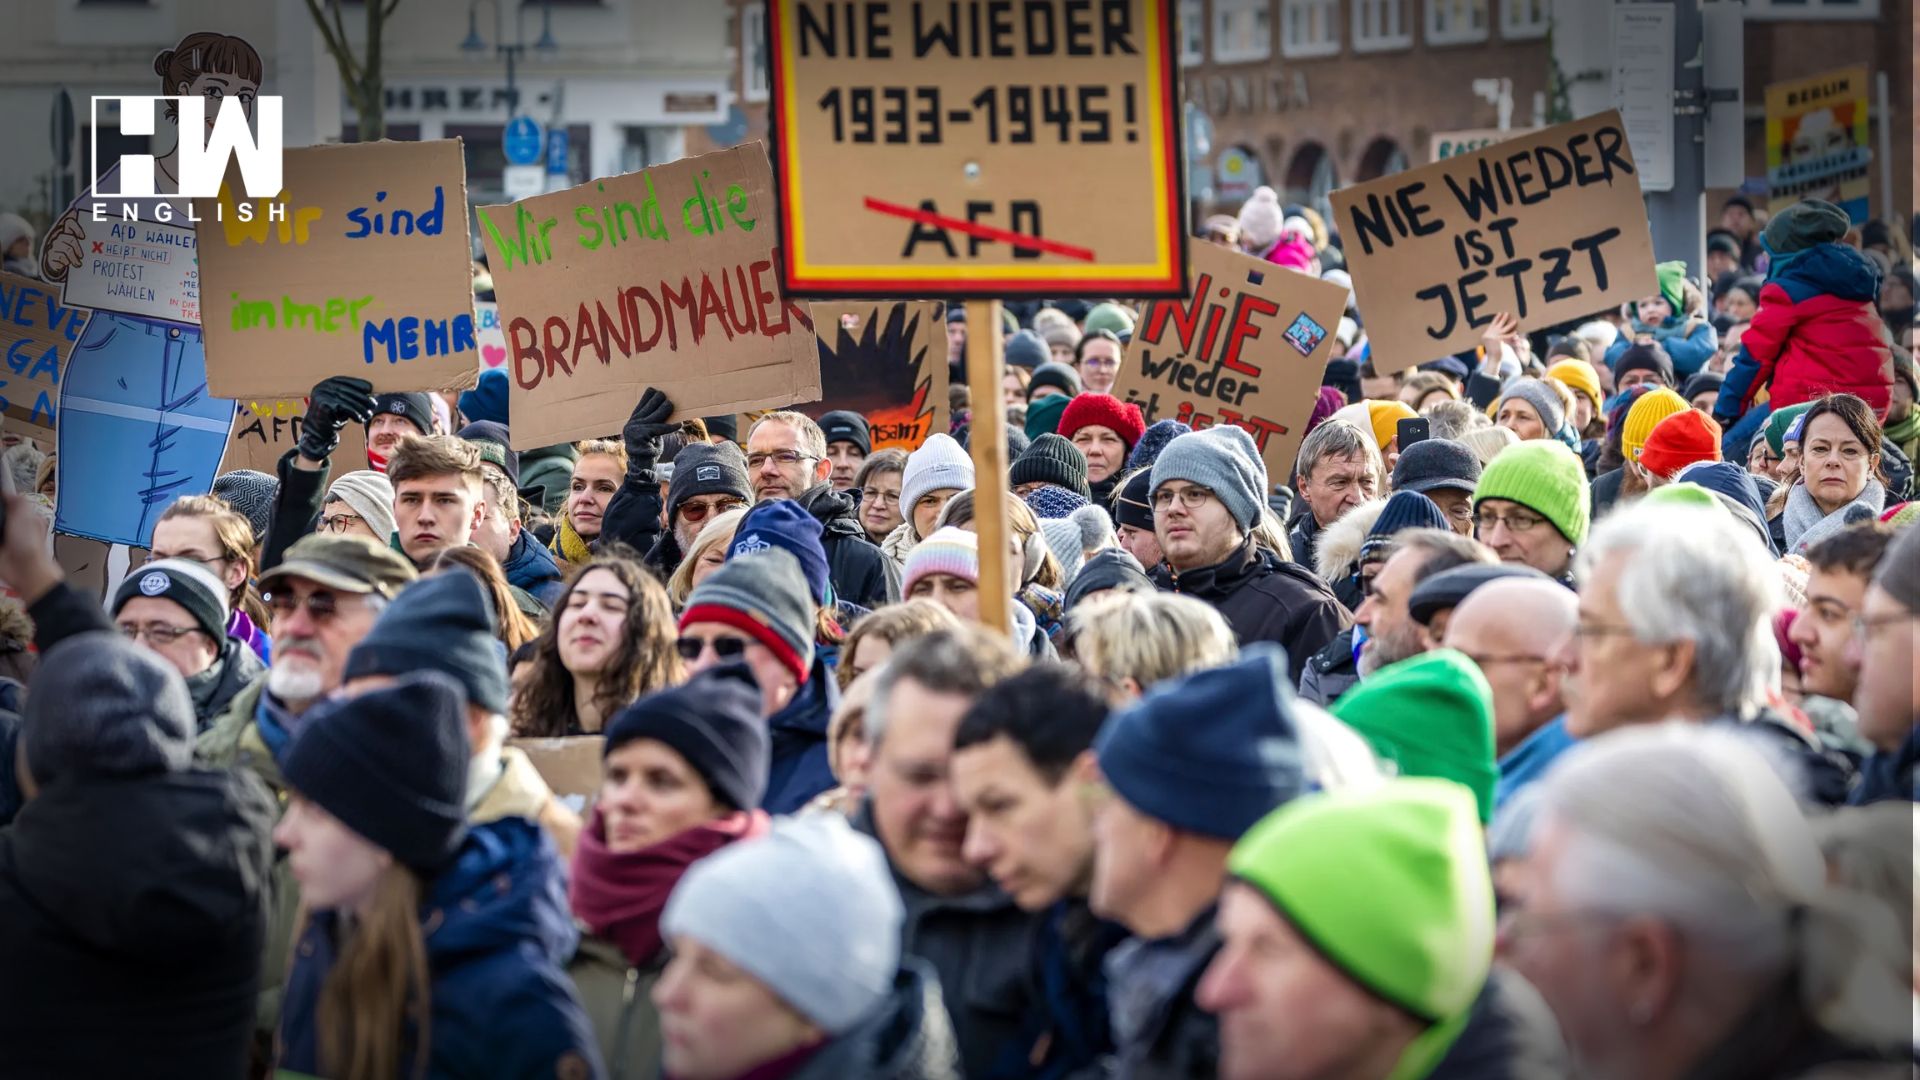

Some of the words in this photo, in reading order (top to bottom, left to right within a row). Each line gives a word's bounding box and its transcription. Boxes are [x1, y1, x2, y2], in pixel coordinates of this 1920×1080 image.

[796, 0, 892, 59] NIE
[911, 0, 1140, 58] WIEDER
[818, 83, 1140, 144] 1933-1945!
[346, 186, 445, 238] sind
[1350, 182, 1445, 255] NIE
[1443, 125, 1635, 223] WIEDER
[477, 203, 559, 271] Wir
[574, 171, 670, 252] sind
[682, 169, 757, 236] die
[902, 200, 1044, 258] AFD
[1454, 217, 1519, 270] IST
[93, 259, 144, 281] PROTEST
[140, 247, 168, 262] NICHT
[106, 282, 155, 301] WÄHLEN
[1415, 227, 1621, 340] JETZT
[230, 291, 375, 334] immer
[362, 313, 476, 364] MEHR
[1141, 349, 1260, 406] wieder
